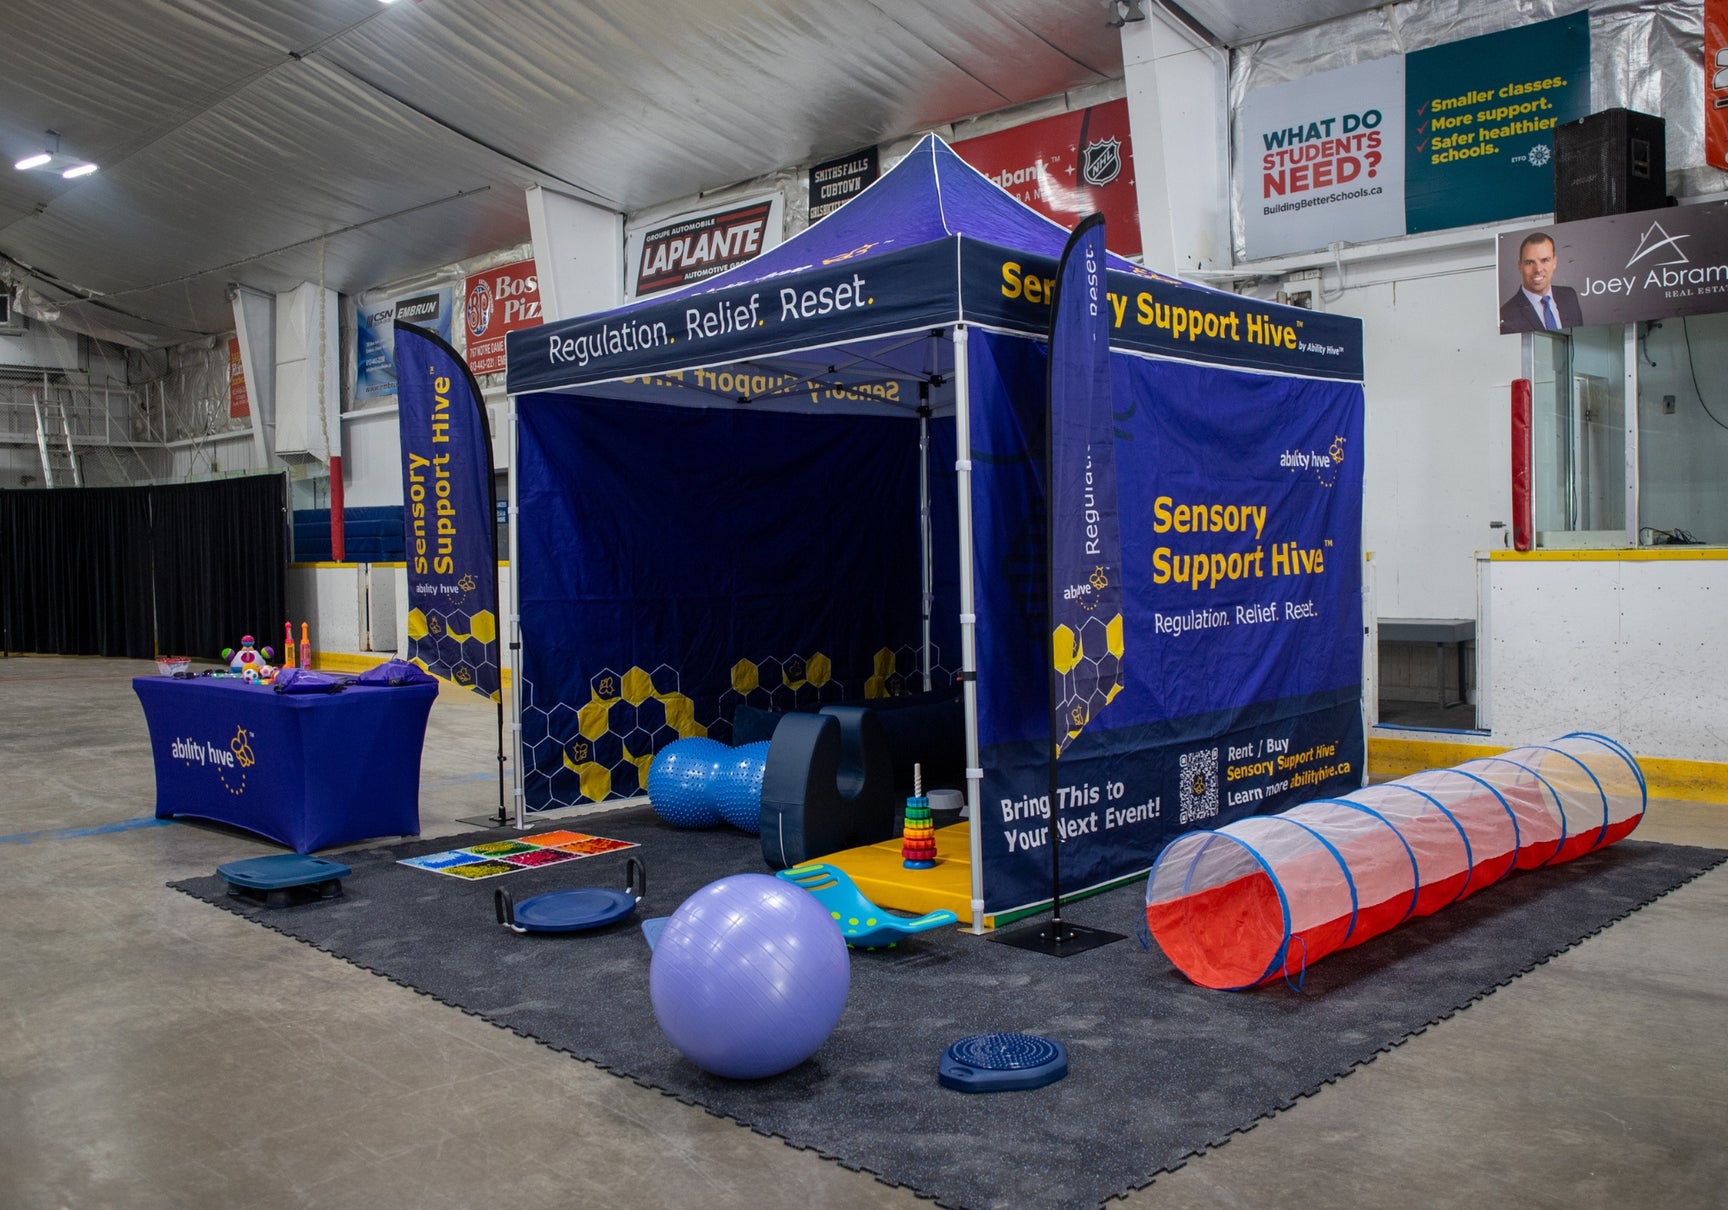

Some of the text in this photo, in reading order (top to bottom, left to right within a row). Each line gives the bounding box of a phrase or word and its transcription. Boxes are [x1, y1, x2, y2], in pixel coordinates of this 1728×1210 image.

[1431, 76, 1567, 112] Smaller classes.
[1263, 109, 1383, 151] WHAT DO
[1431, 97, 1552, 131] More support.
[1431, 116, 1557, 150] Safer healthier
[1092, 148, 1113, 177] NHL
[1263, 130, 1381, 171] STUDENTS
[1431, 143, 1499, 165] schools.
[1511, 155, 1526, 163] ETFO
[815, 158, 869, 183] SMITHS FALLS
[1263, 150, 1382, 198] NEED?
[821, 177, 861, 198] CUBTOWN
[1263, 186, 1382, 215] BuildingBetterSchools.ca
[646, 218, 716, 242] GROUPE AUTOMOBILE
[642, 220, 763, 277] LAPLANTE
[684, 263, 728, 280] AUTOMOTIVE
[1581, 275, 1636, 297] Joey
[397, 301, 437, 319] EMBRUN
[1665, 289, 1694, 298] REAL
[374, 309, 393, 321] CSN
[549, 319, 675, 366] Regulation.
[686, 294, 764, 340] Relief.
[780, 273, 874, 322] Reset.
[1137, 292, 1239, 341] Support
[1298, 340, 1307, 353] by
[1307, 343, 1326, 356] Ability
[1280, 448, 1330, 470] ability hive
[409, 453, 430, 575] Sensory
[432, 453, 457, 575] Support
[1153, 495, 1267, 540] Sensory
[1152, 545, 1264, 591] Support
[415, 582, 459, 596] ability hive
[1155, 608, 1230, 637] Regulation.
[1235, 602, 1279, 625] Relief.
[171, 736, 234, 768] ability hive
[1226, 760, 1274, 781] Sensory
[1277, 748, 1314, 770] Support
[1228, 738, 1289, 762] Rent / Buy
[1227, 762, 1351, 807] Learn more abilityhive.ca
[1000, 780, 1125, 823] Bring This to
[1004, 796, 1161, 854] Your Next Event!
